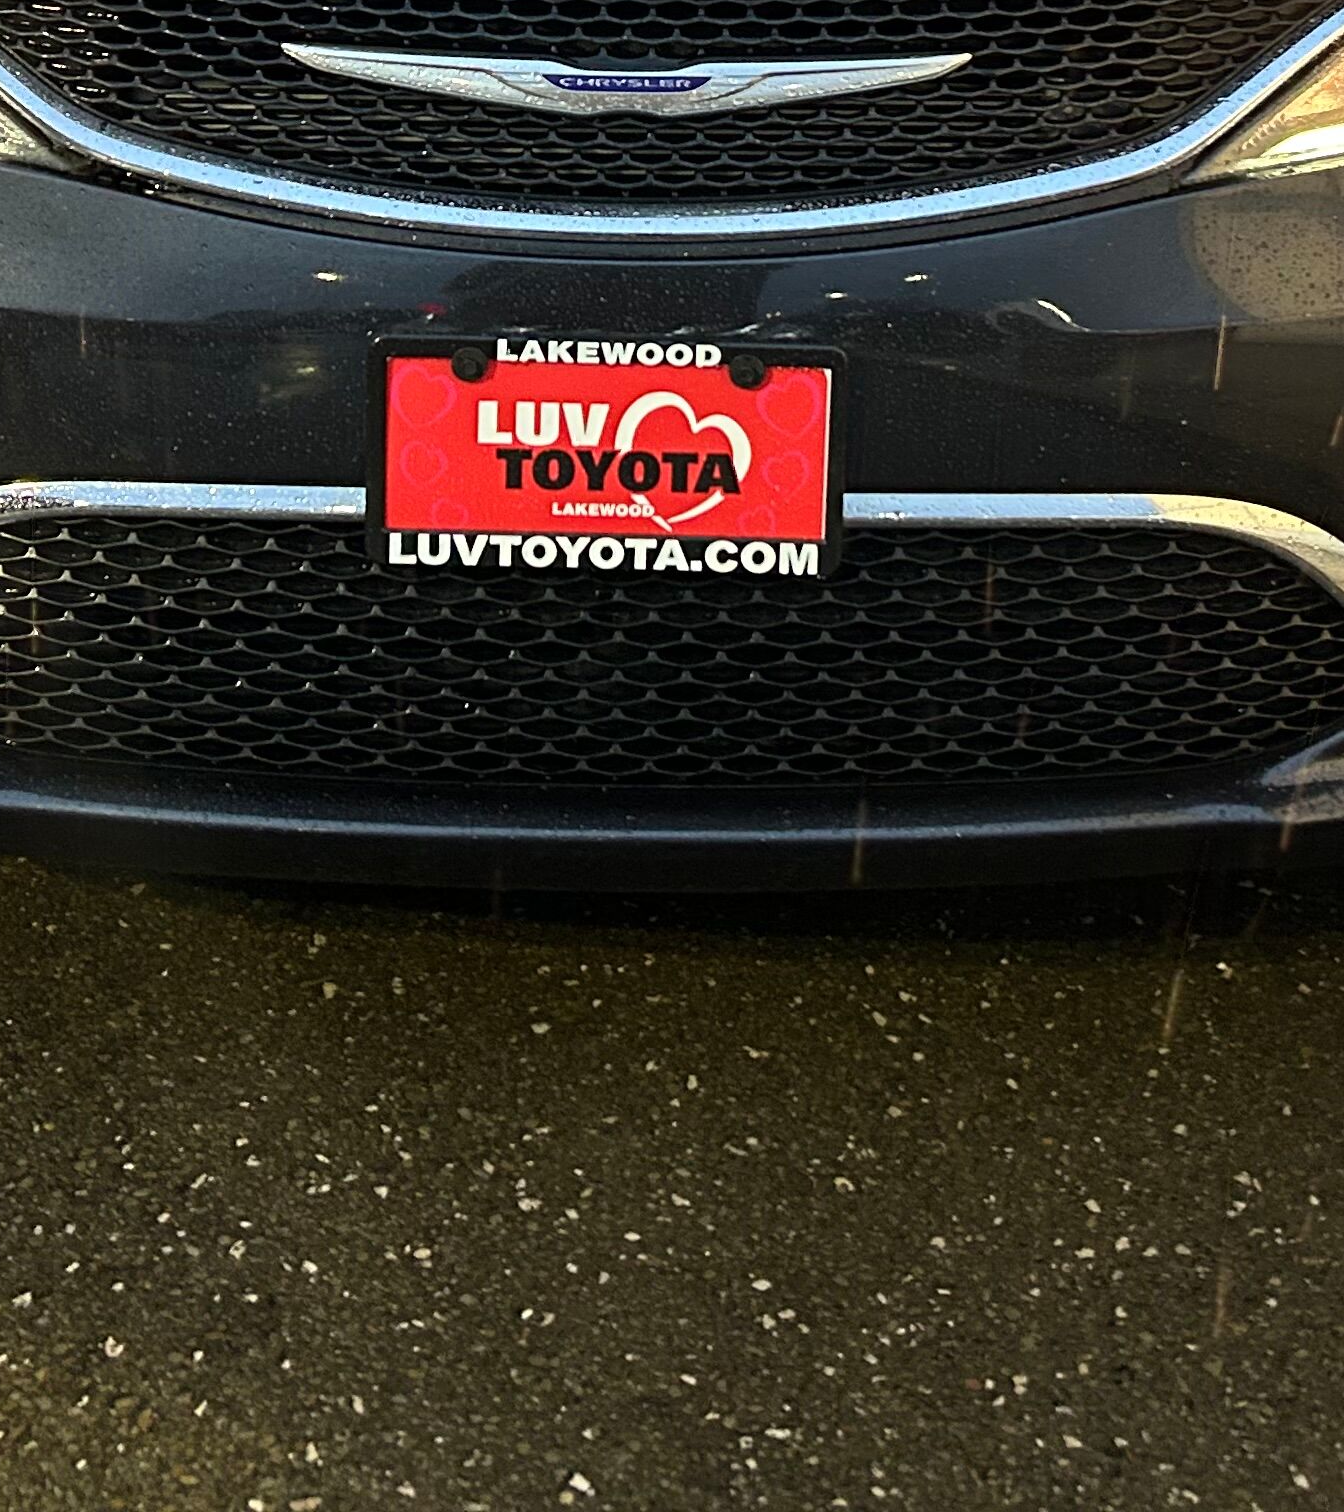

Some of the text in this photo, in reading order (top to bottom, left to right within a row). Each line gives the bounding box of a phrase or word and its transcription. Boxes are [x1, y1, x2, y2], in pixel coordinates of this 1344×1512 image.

[559, 76, 691, 88] CHRYSLER
[496, 338, 722, 368] LAKEWOOD
[476, 400, 610, 447] LUV
[496, 448, 741, 495] TOYOTA
[551, 501, 655, 519] LAKEWOOD
[388, 531, 819, 576] LUVTOYOTA.COM
